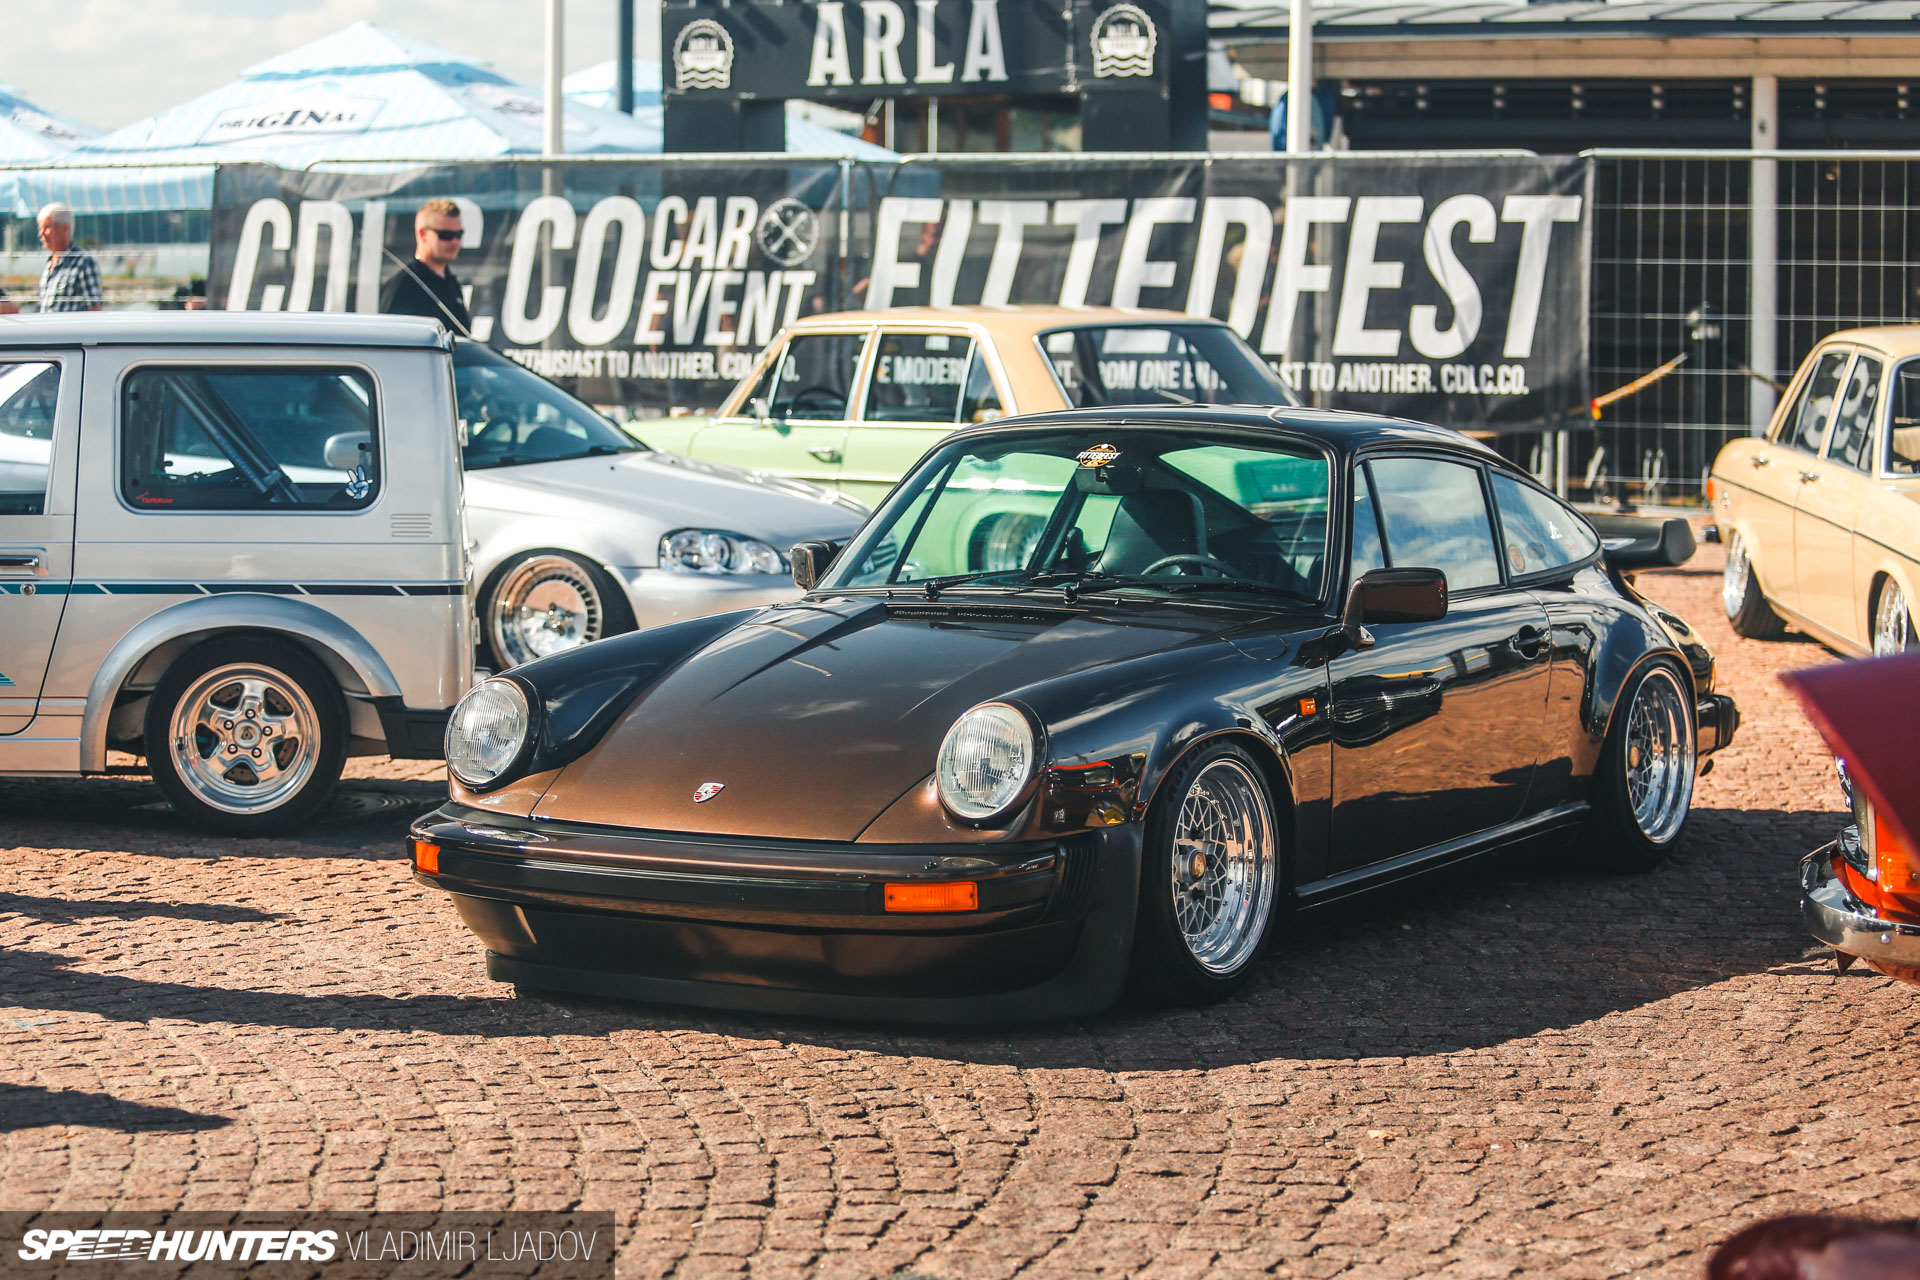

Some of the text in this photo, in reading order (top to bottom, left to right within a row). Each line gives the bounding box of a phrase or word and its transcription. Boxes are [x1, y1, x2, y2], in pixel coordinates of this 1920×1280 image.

[806, 0, 1010, 86] ARLA
[219, 109, 358, 129] ORIGINAL
[650, 196, 759, 271] CAR
[633, 270, 817, 347] EVENT
[864, 194, 1583, 359] FITTEDFEST
[607, 349, 630, 379] TO
[632, 351, 719, 380] ANOTHER.
[1139, 360, 1181, 390] ONE
[1307, 361, 1336, 391] TO
[1337, 362, 1438, 393] ANOTHER.
